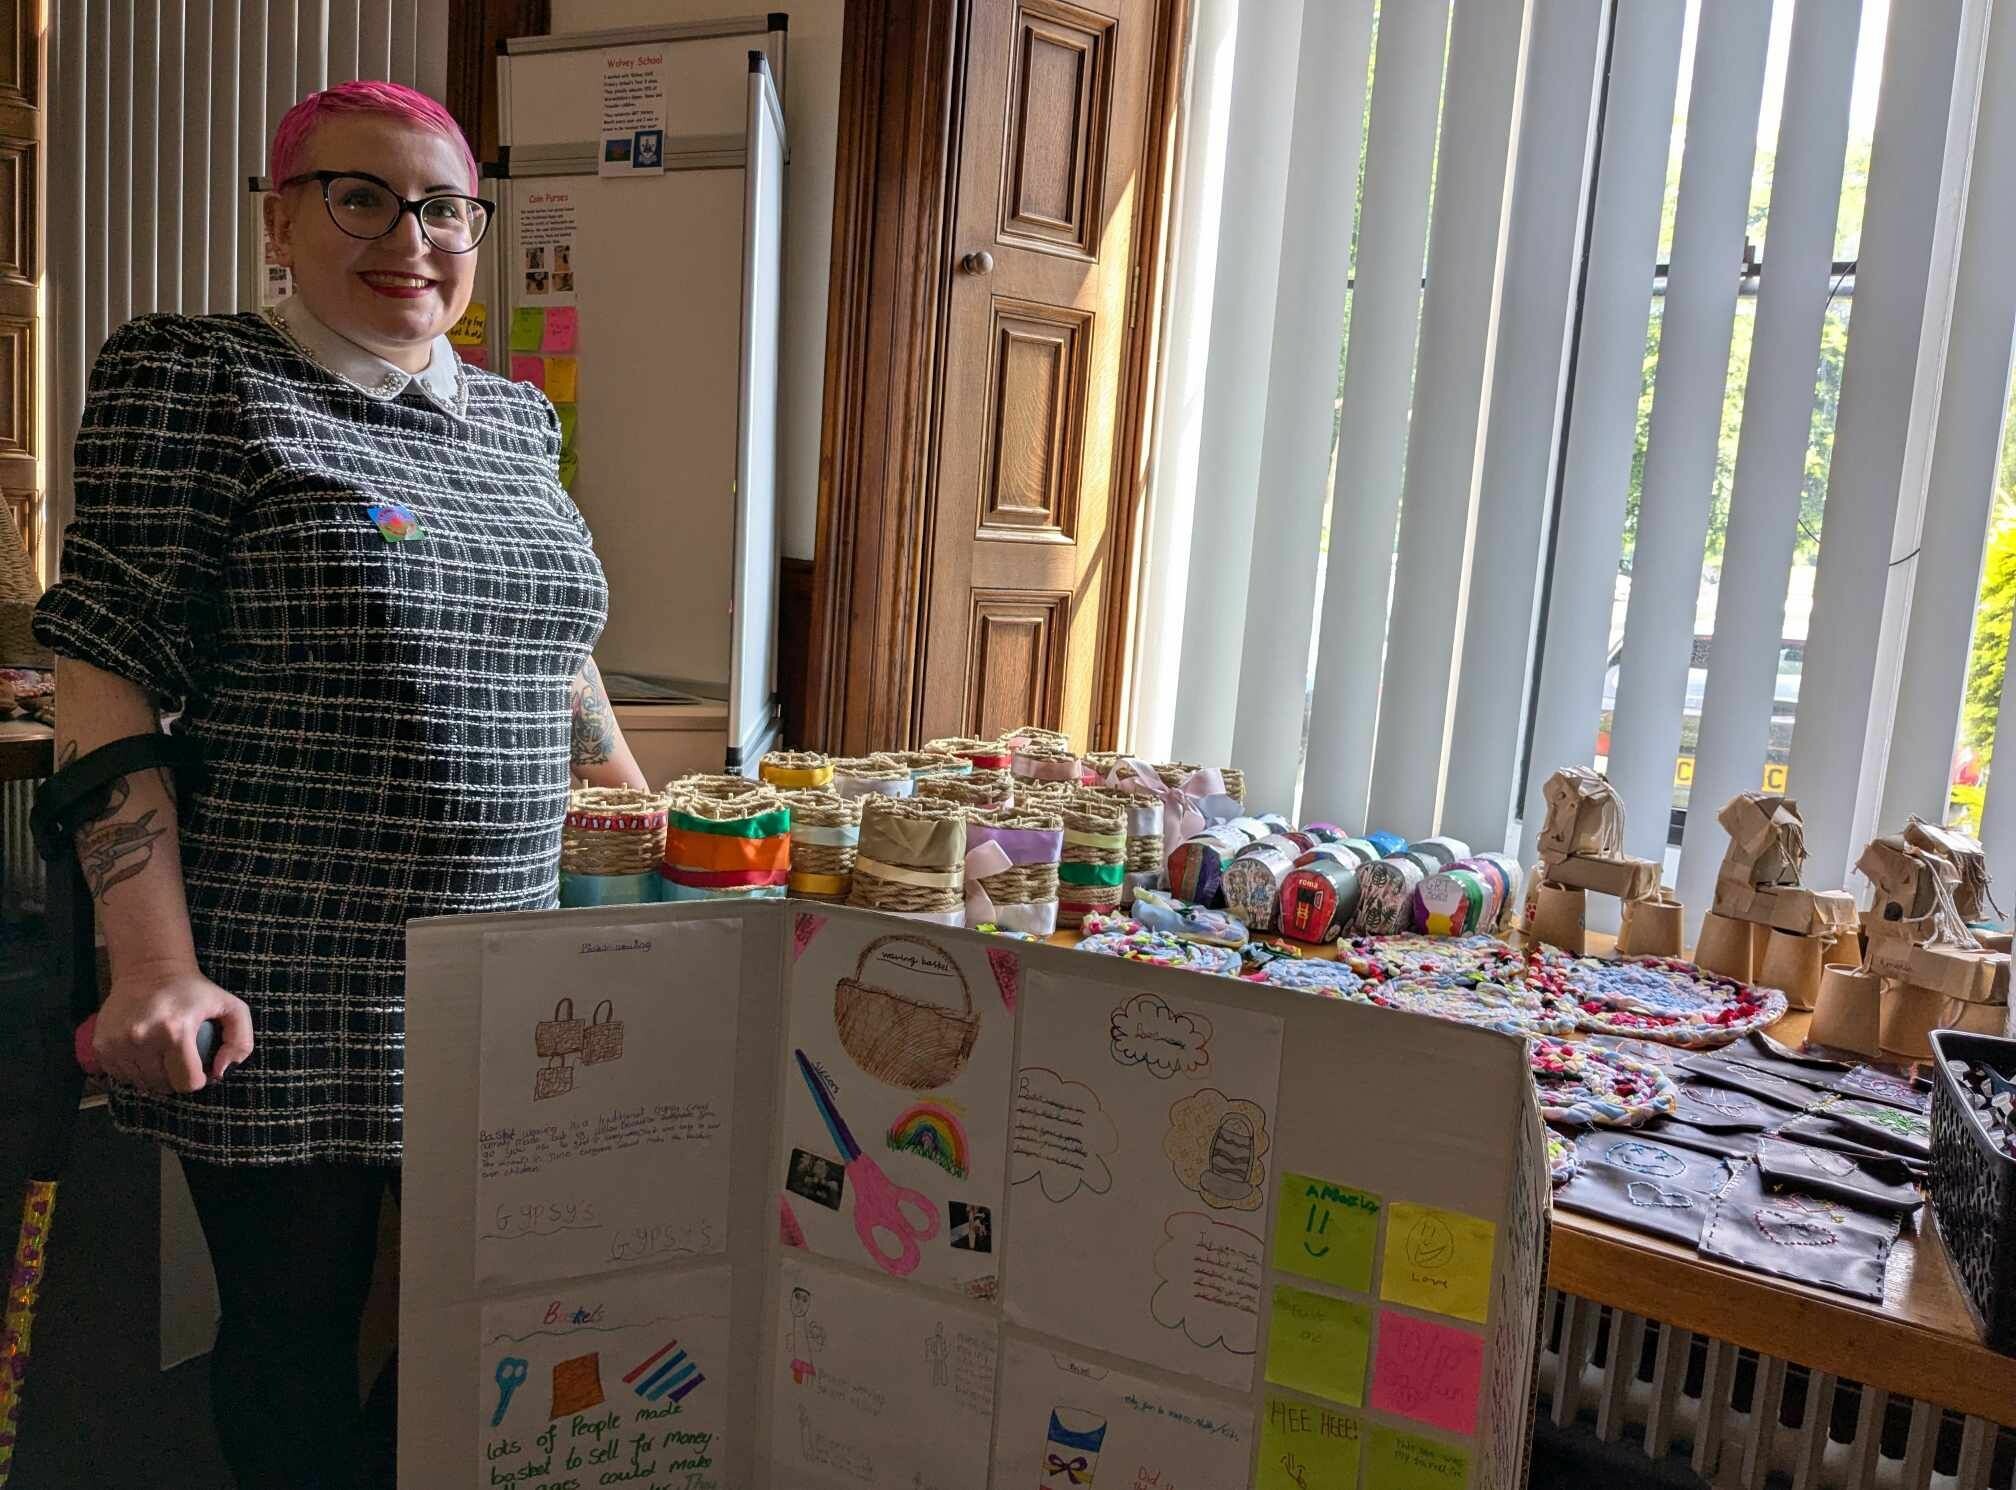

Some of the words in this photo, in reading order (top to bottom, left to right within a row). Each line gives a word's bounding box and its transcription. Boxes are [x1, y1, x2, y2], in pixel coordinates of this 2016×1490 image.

[638, 54, 663, 66] School
[1677, 761, 1691, 781] C
[1766, 768, 1783, 789] C
[536, 1424, 557, 1454] of
[635, 1401, 683, 1422] made
[491, 1455, 552, 1486] basket
[566, 1446, 583, 1471] to
[599, 1460, 657, 1486] could
[669, 1454, 713, 1473] make
